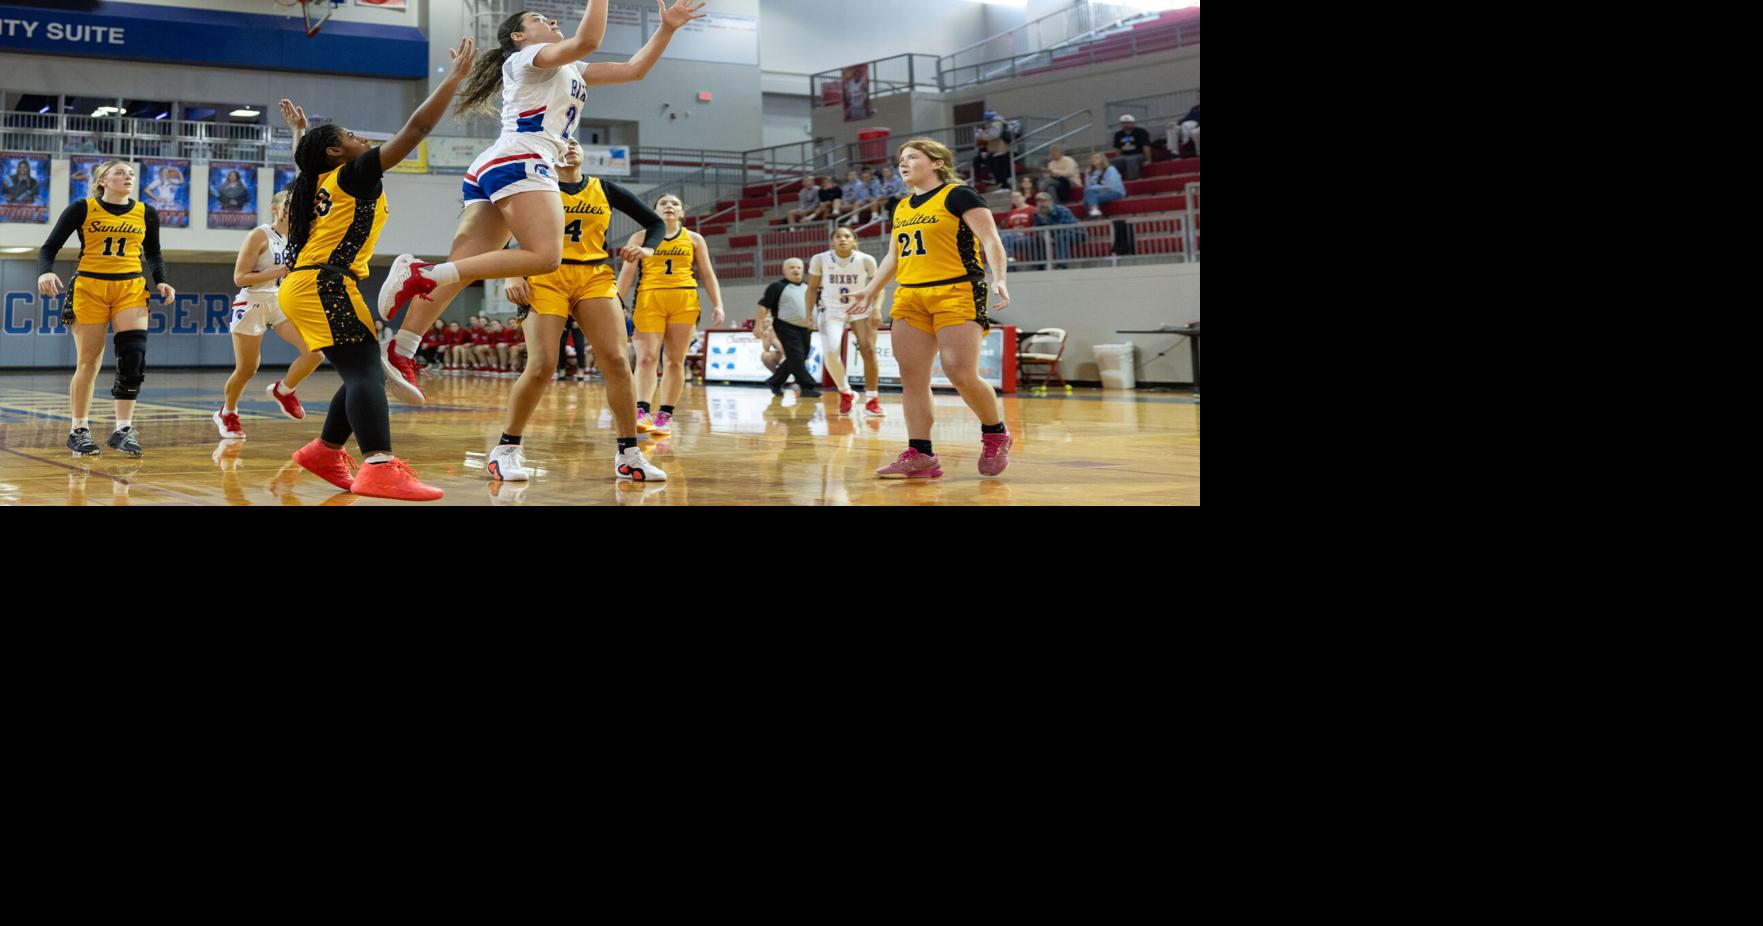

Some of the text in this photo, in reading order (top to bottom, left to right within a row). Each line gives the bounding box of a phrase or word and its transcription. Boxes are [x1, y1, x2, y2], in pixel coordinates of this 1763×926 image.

[46, 22, 125, 45] SUITE
[88, 220, 143, 234] Sandites
[564, 218, 582, 243] 4
[102, 236, 127, 256] 11
[897, 229, 927, 258] 21
[664, 258, 673, 275] 1
[829, 273, 858, 284] BIXBY
[3, 290, 234, 336] CHGER
